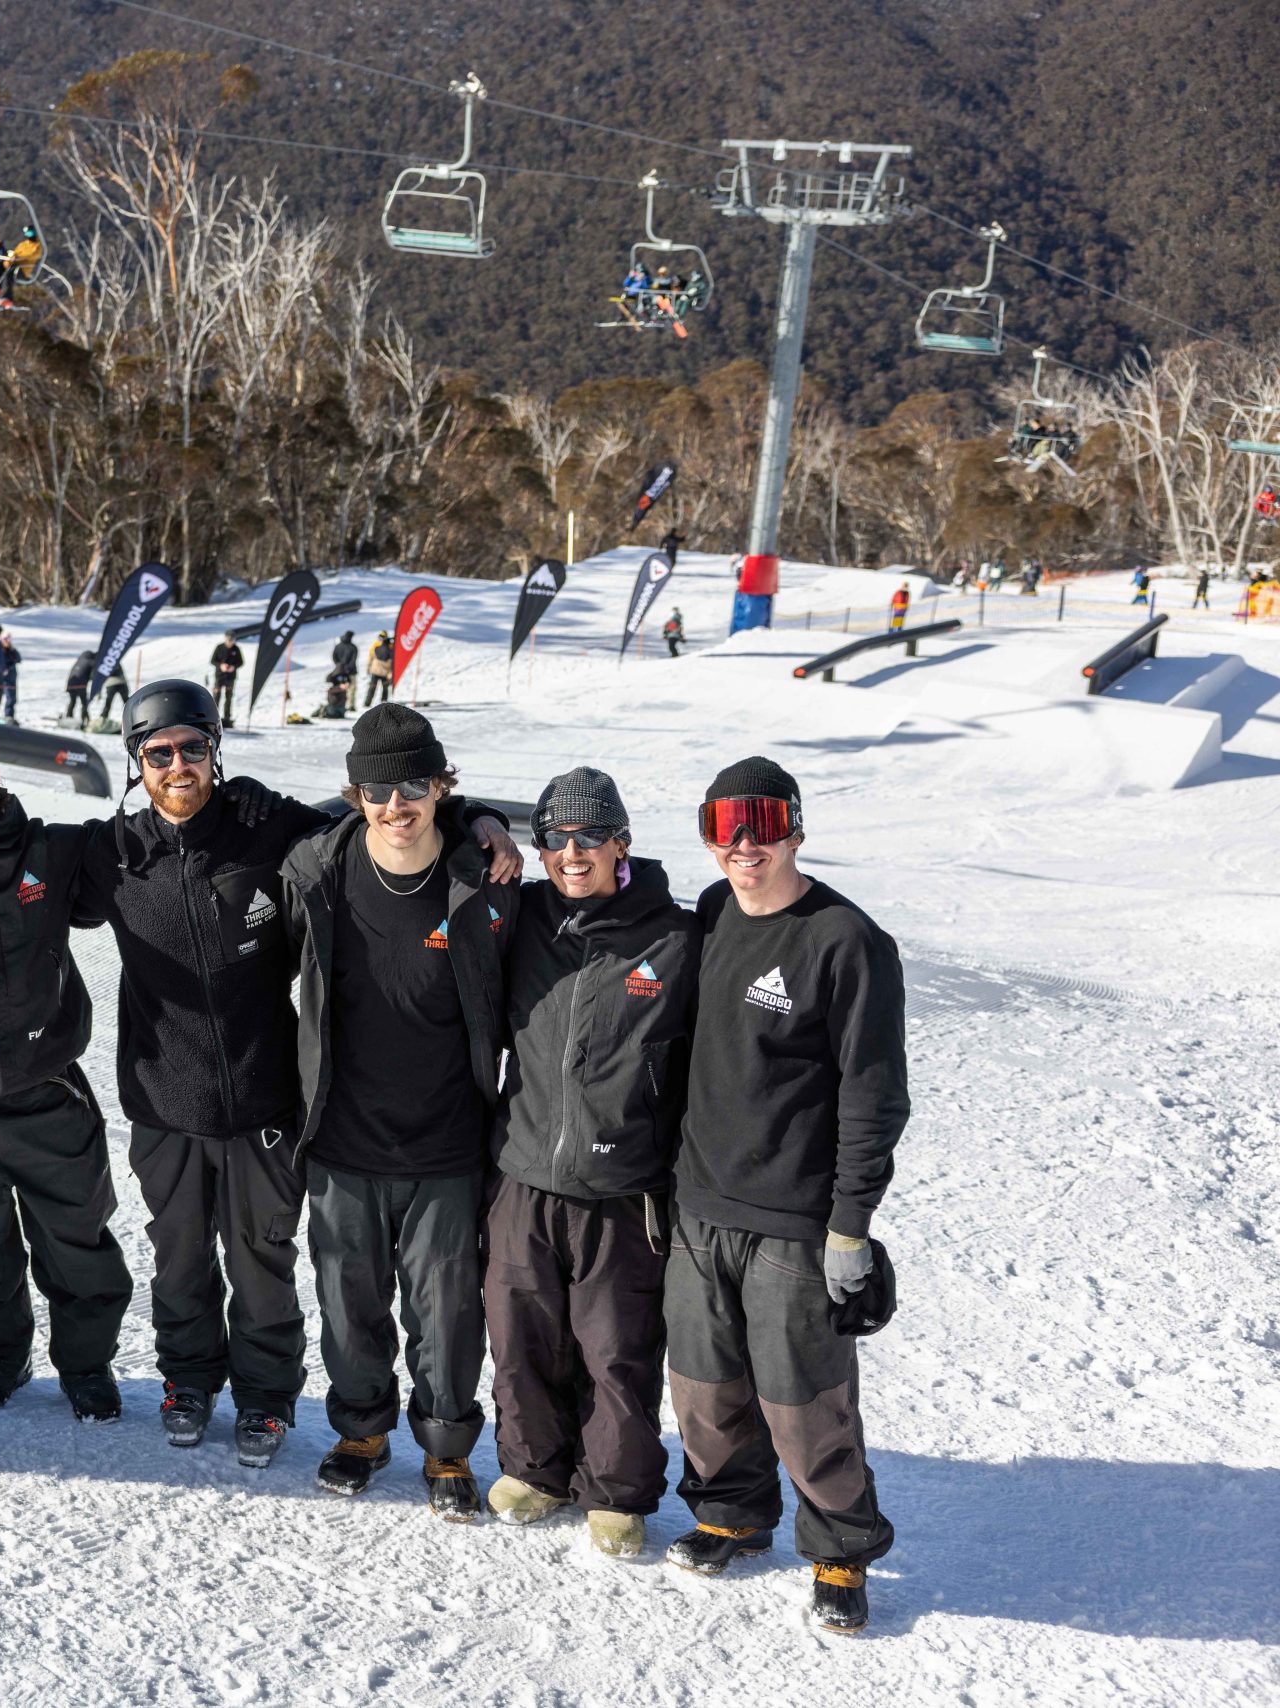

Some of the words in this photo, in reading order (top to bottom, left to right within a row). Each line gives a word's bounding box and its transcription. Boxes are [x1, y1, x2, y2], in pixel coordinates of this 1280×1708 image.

[273, 589, 312, 647] OAKLEY
[97, 604, 147, 677] ROSSIGNOL
[16, 882, 47, 900] THREDBO
[21, 891, 45, 906] PARKS
[243, 902, 277, 924] THREDBO
[246, 919, 264, 930] PARK
[624, 978, 663, 990] THREDBO
[627, 987, 657, 998] PARKS
[746, 986, 793, 1010] THREDBO
